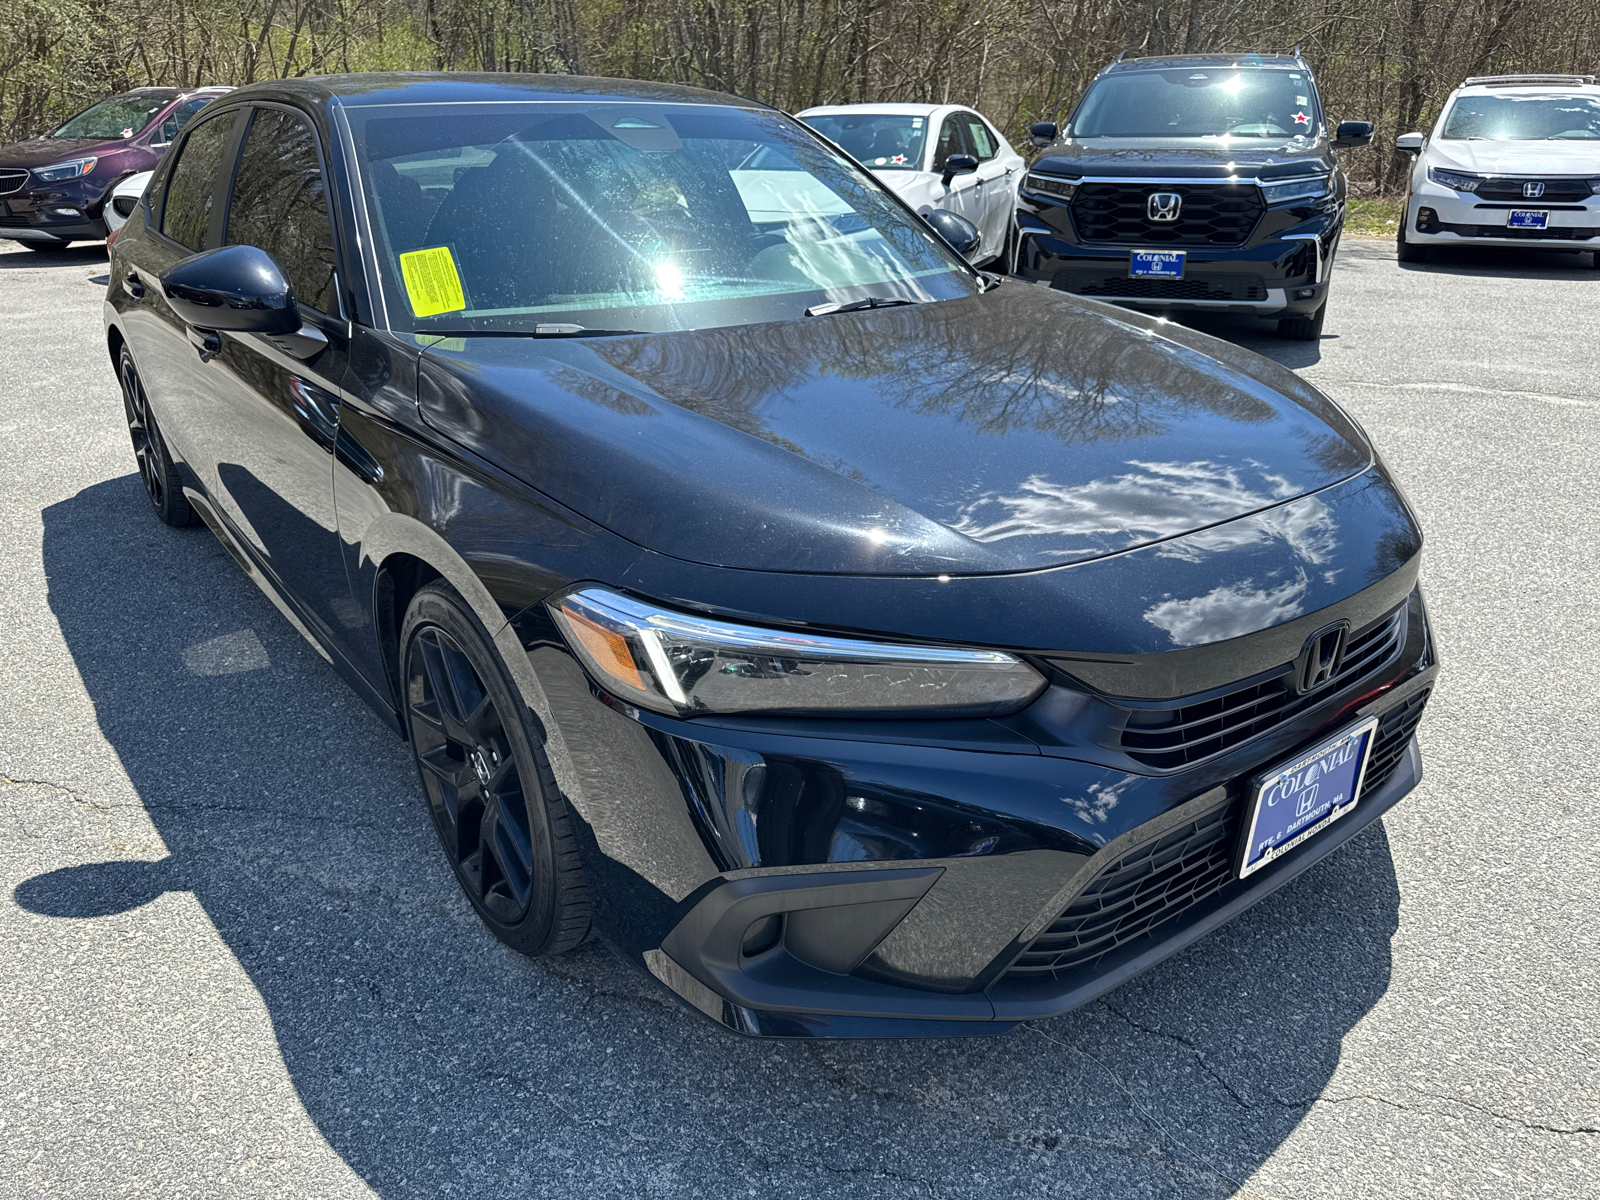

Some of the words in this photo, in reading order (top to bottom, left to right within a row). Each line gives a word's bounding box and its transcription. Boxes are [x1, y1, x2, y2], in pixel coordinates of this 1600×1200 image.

[1136, 254, 1179, 263] COLONIAL
[1267, 744, 1354, 807] COLONIAL
[1258, 836, 1275, 852] RTE.
[1276, 831, 1282, 840] 6
[1332, 792, 1344, 805] MA
[1271, 833, 1306, 860] COLONIAL
[1307, 817, 1331, 838] HONDA
